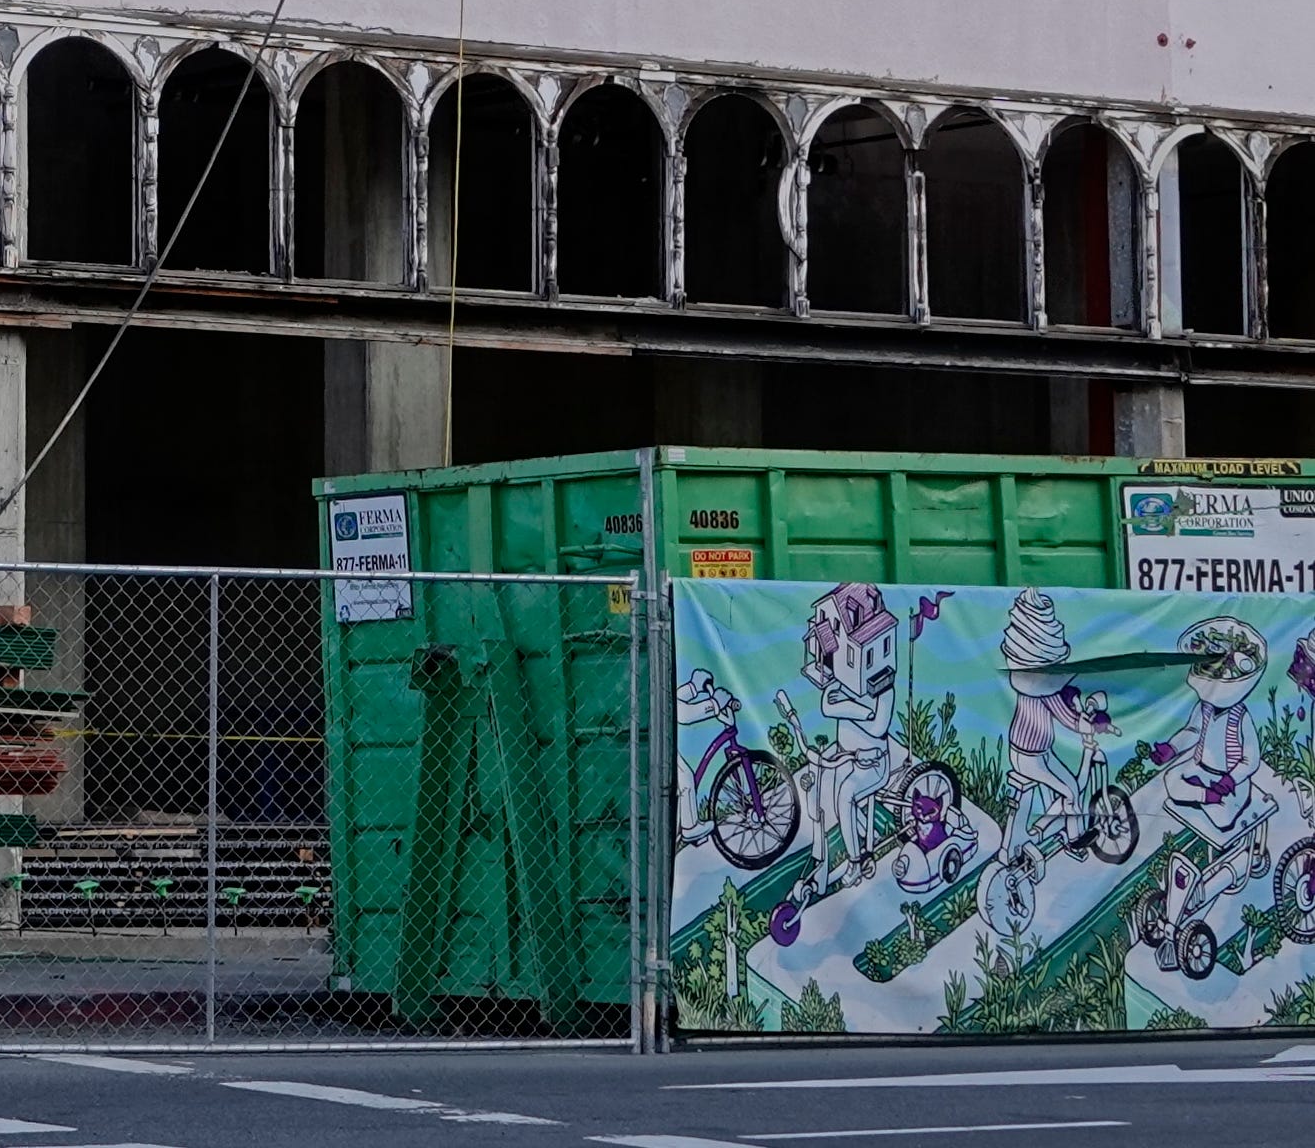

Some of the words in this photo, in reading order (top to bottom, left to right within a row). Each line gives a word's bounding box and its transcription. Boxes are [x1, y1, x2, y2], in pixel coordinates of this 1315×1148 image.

[1154, 462, 1207, 474] MAXIMUM
[1213, 463, 1245, 474] LOAD
[1250, 463, 1284, 475] LEVEL
[1284, 489, 1315, 503] UNIO
[1187, 493, 1254, 516] ERMA
[360, 509, 402, 525] FERMA
[605, 514, 642, 534] 40836
[689, 509, 740, 529] 40836
[1179, 516, 1254, 528] CORPORATION
[694, 552, 705, 561] DO
[708, 552, 726, 561] NOT
[729, 552, 749, 561] PARK
